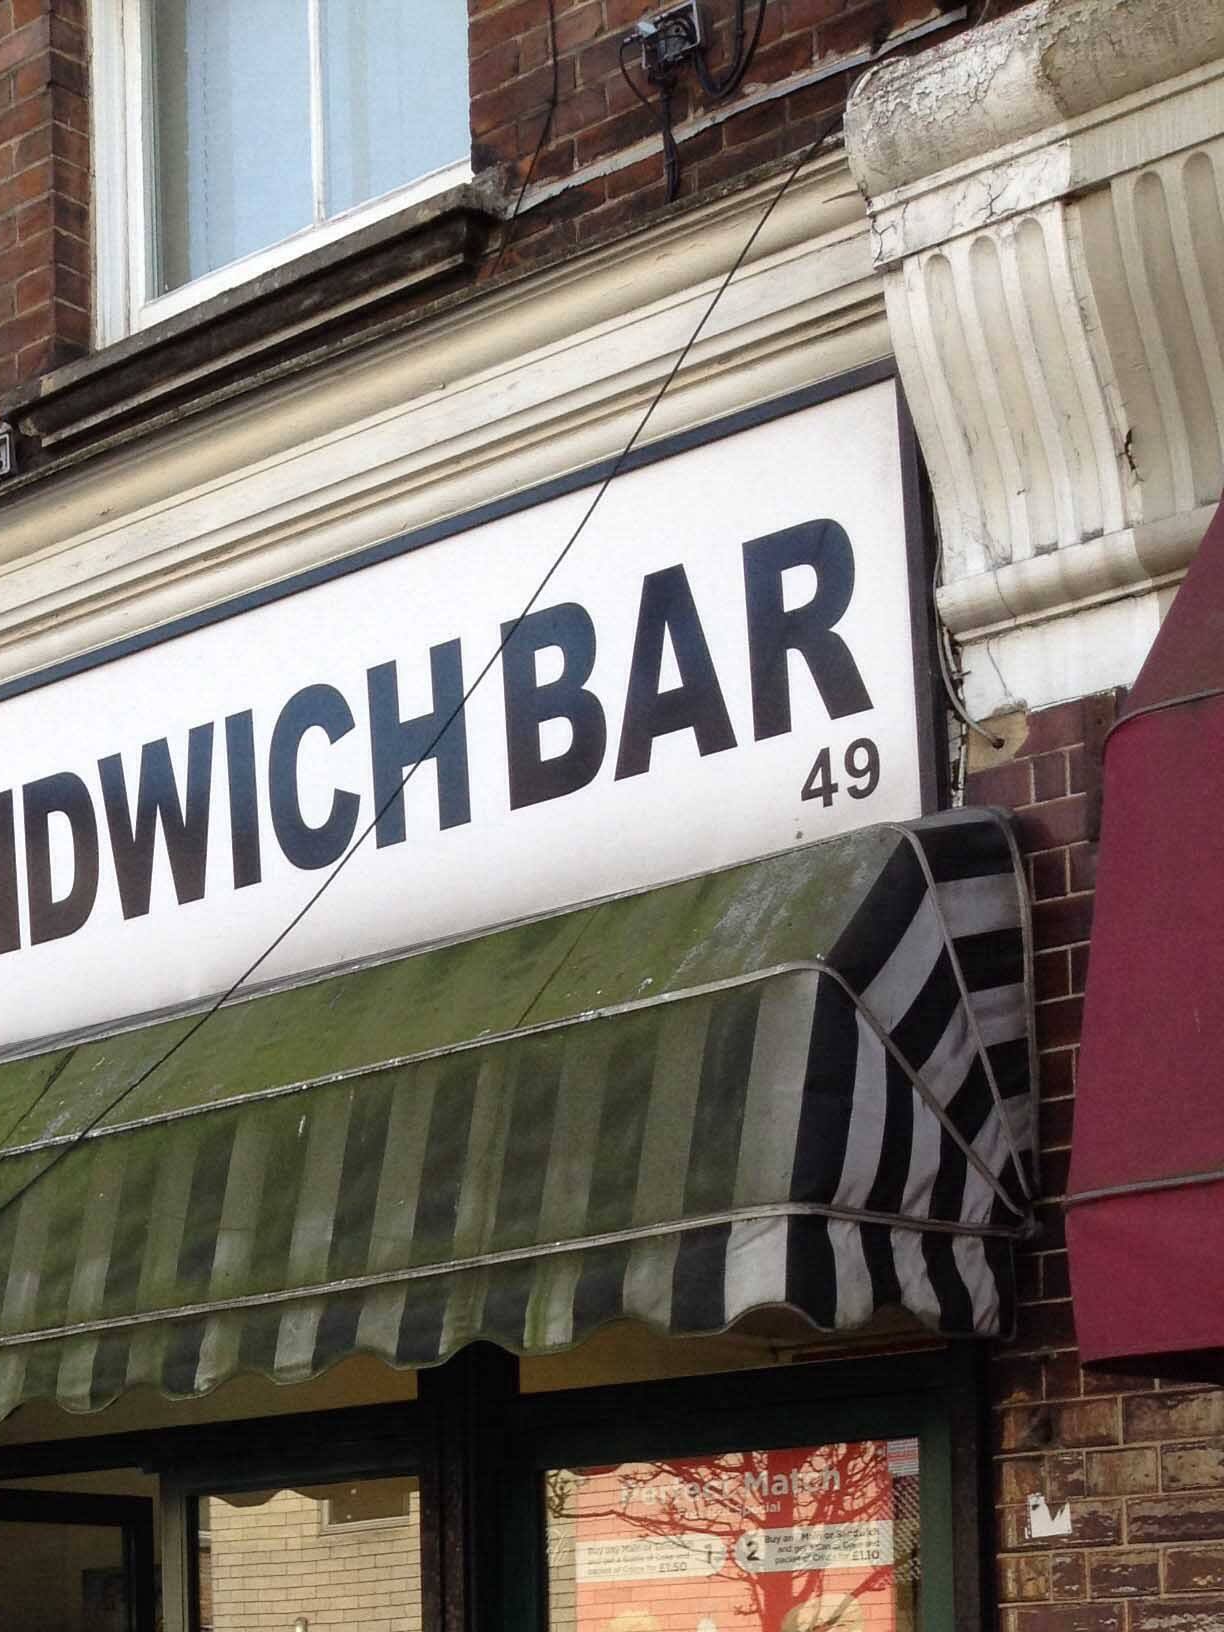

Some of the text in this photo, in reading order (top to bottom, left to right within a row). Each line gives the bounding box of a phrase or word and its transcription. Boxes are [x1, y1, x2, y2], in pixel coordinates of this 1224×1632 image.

[500, 517, 874, 811] BAR
[800, 736, 882, 809] 49
[746, 1540, 761, 1561] 2
